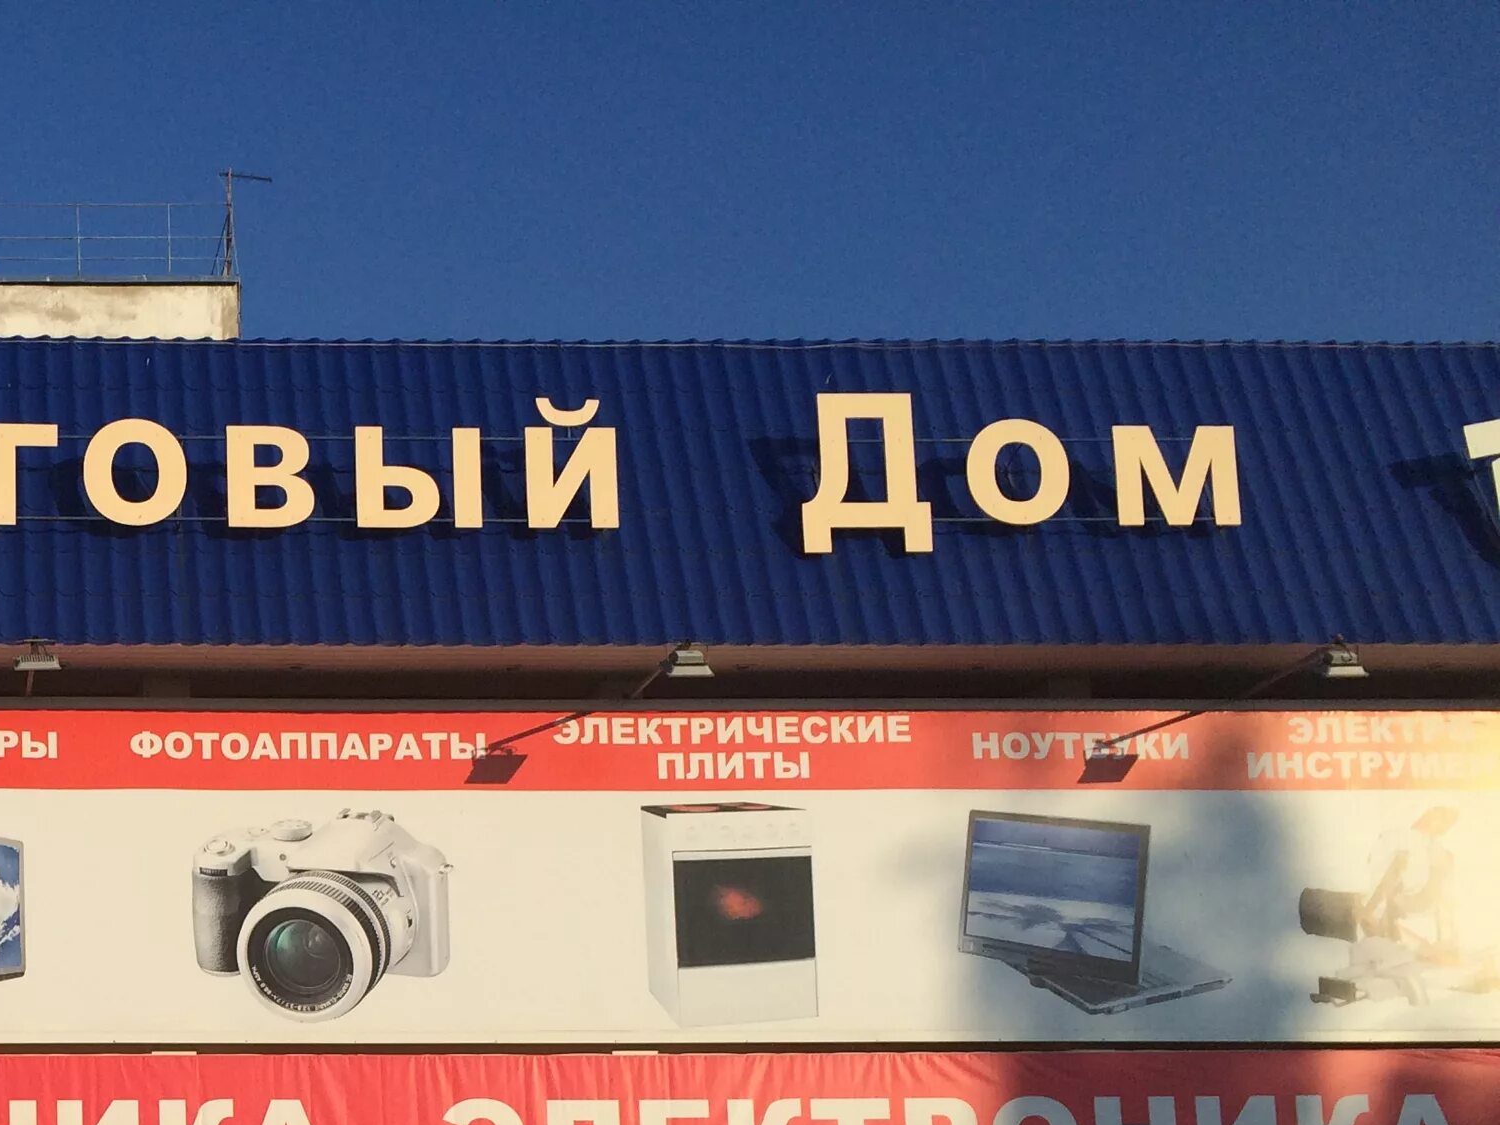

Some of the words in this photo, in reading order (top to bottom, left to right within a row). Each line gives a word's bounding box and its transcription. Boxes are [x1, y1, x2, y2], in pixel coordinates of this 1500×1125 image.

[802, 393, 1241, 553] Дом
[553, 715, 912, 745] ЭЛЕКТРИЧЕСКИЕ
[129, 731, 489, 761] ФОТОАППАРАТЫ
[971, 731, 1190, 761] НОУТБУКИ
[657, 751, 810, 780] ПЛИТЫ
